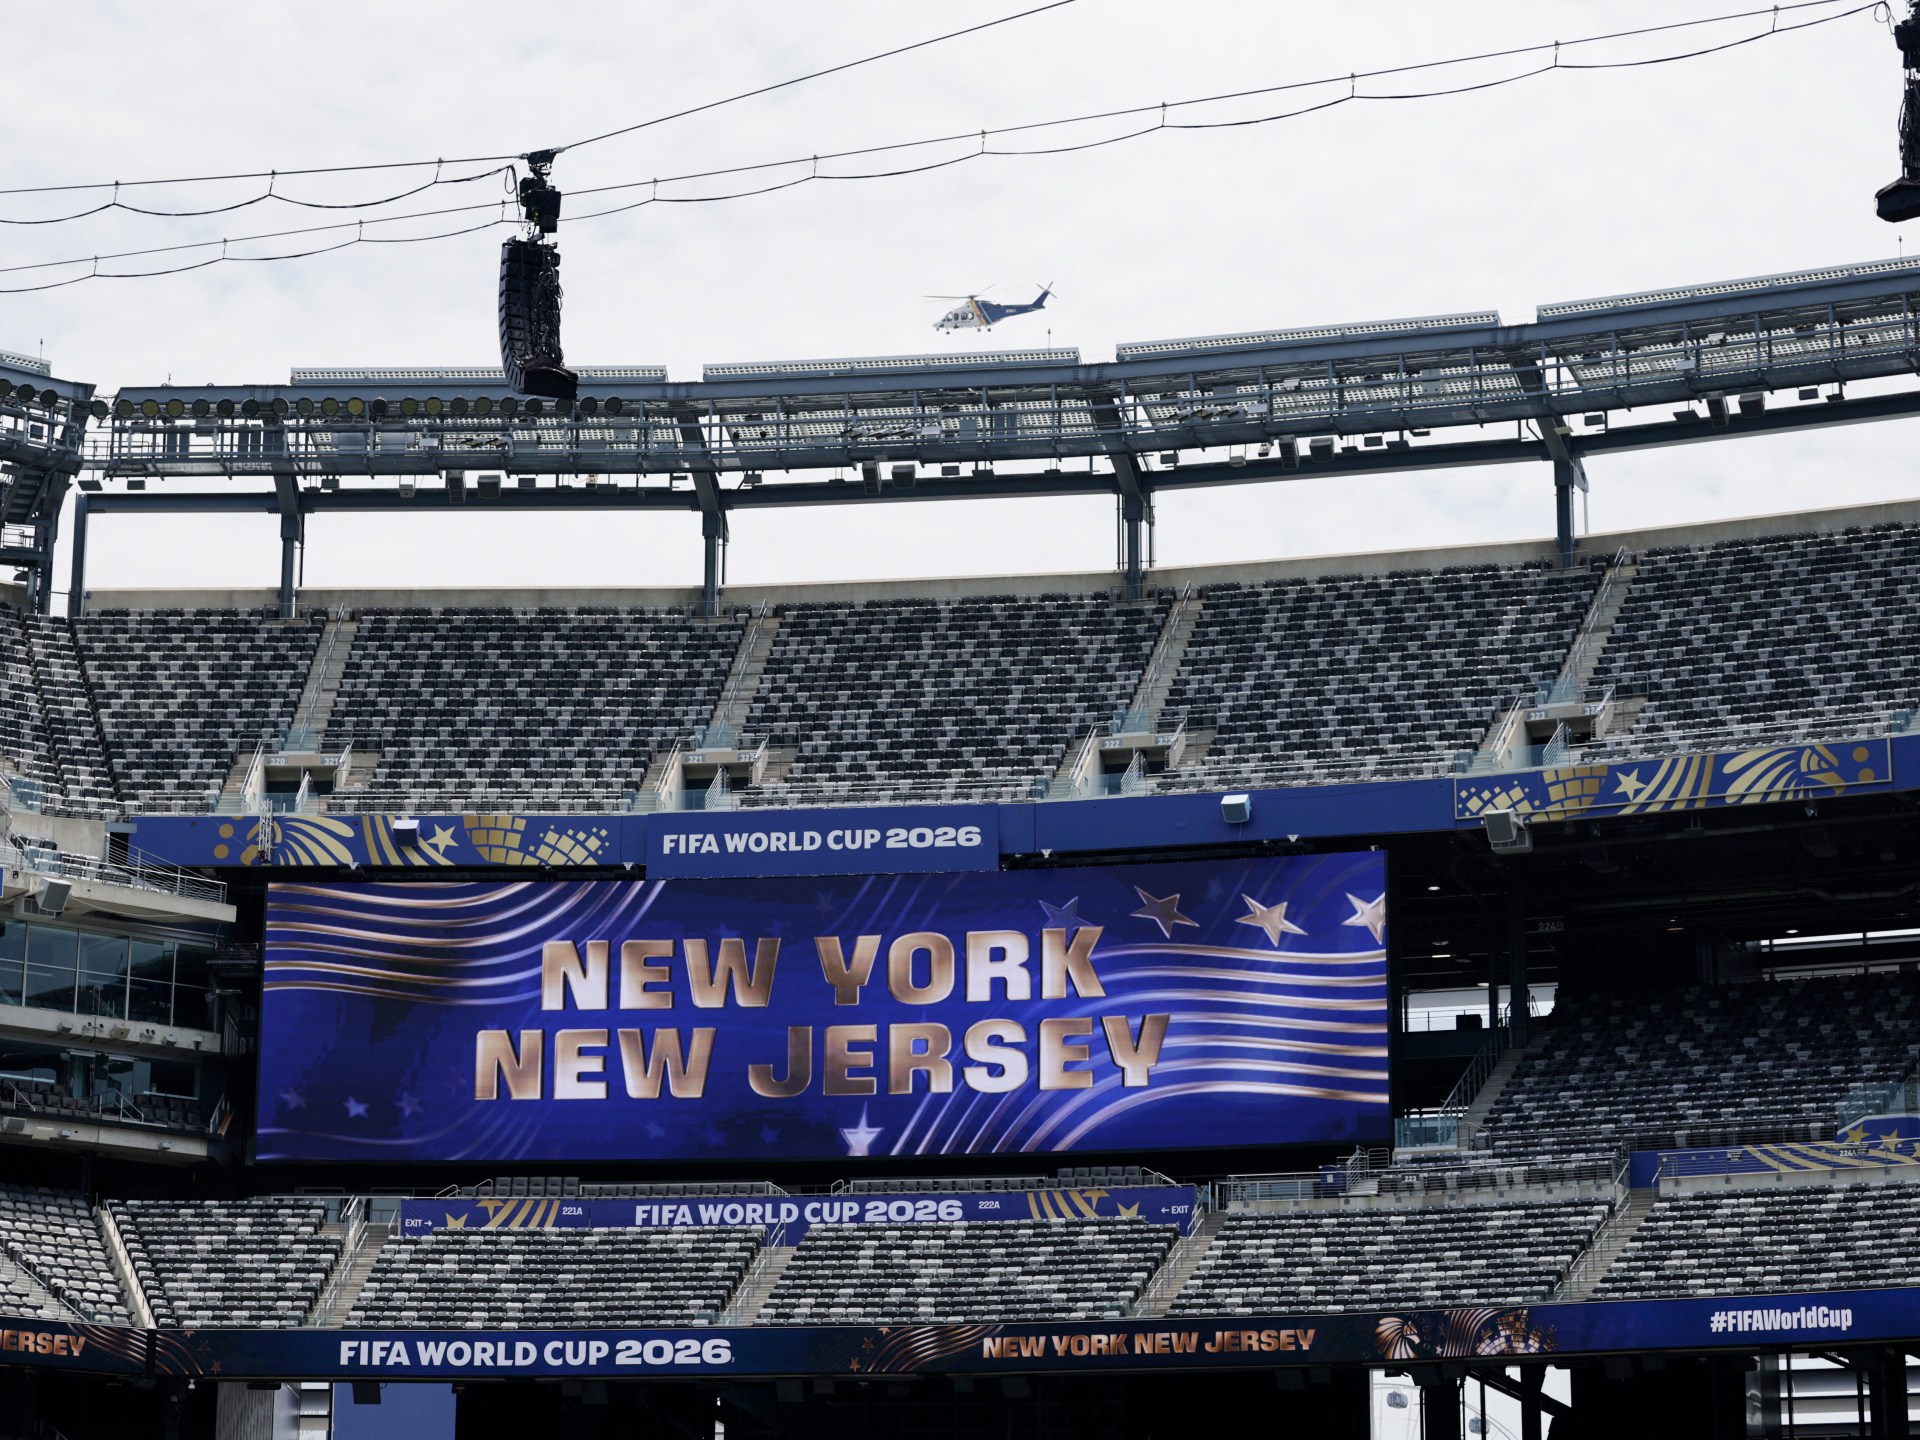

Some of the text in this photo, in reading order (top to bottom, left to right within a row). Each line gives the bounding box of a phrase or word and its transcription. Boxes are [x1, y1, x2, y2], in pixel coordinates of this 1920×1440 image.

[1530, 711, 1546, 720] 323
[1105, 740, 1120, 748] 322
[324, 757, 339, 765] 321
[688, 755, 703, 763] 321
[663, 826, 982, 854] FIFA WORLD CUP 2026
[540, 925, 1106, 1011] NEW YORK
[474, 1013, 1171, 1100] NEW JERSEY
[562, 1206, 583, 1215] 221A
[635, 1200, 964, 1226] FIFA WORLD CUP 2026
[978, 1201, 1000, 1210] 222A
[1171, 1205, 1190, 1215] EXIT
[405, 1219, 423, 1227] EXIT
[1710, 1305, 1853, 1333] #FIFAWorldCup
[0, 1328, 87, 1357] ERSEY
[983, 1329, 1316, 1359] NEW YORK NEW JERSEY
[339, 1338, 732, 1367] FIFA WORLD CUP 2026
